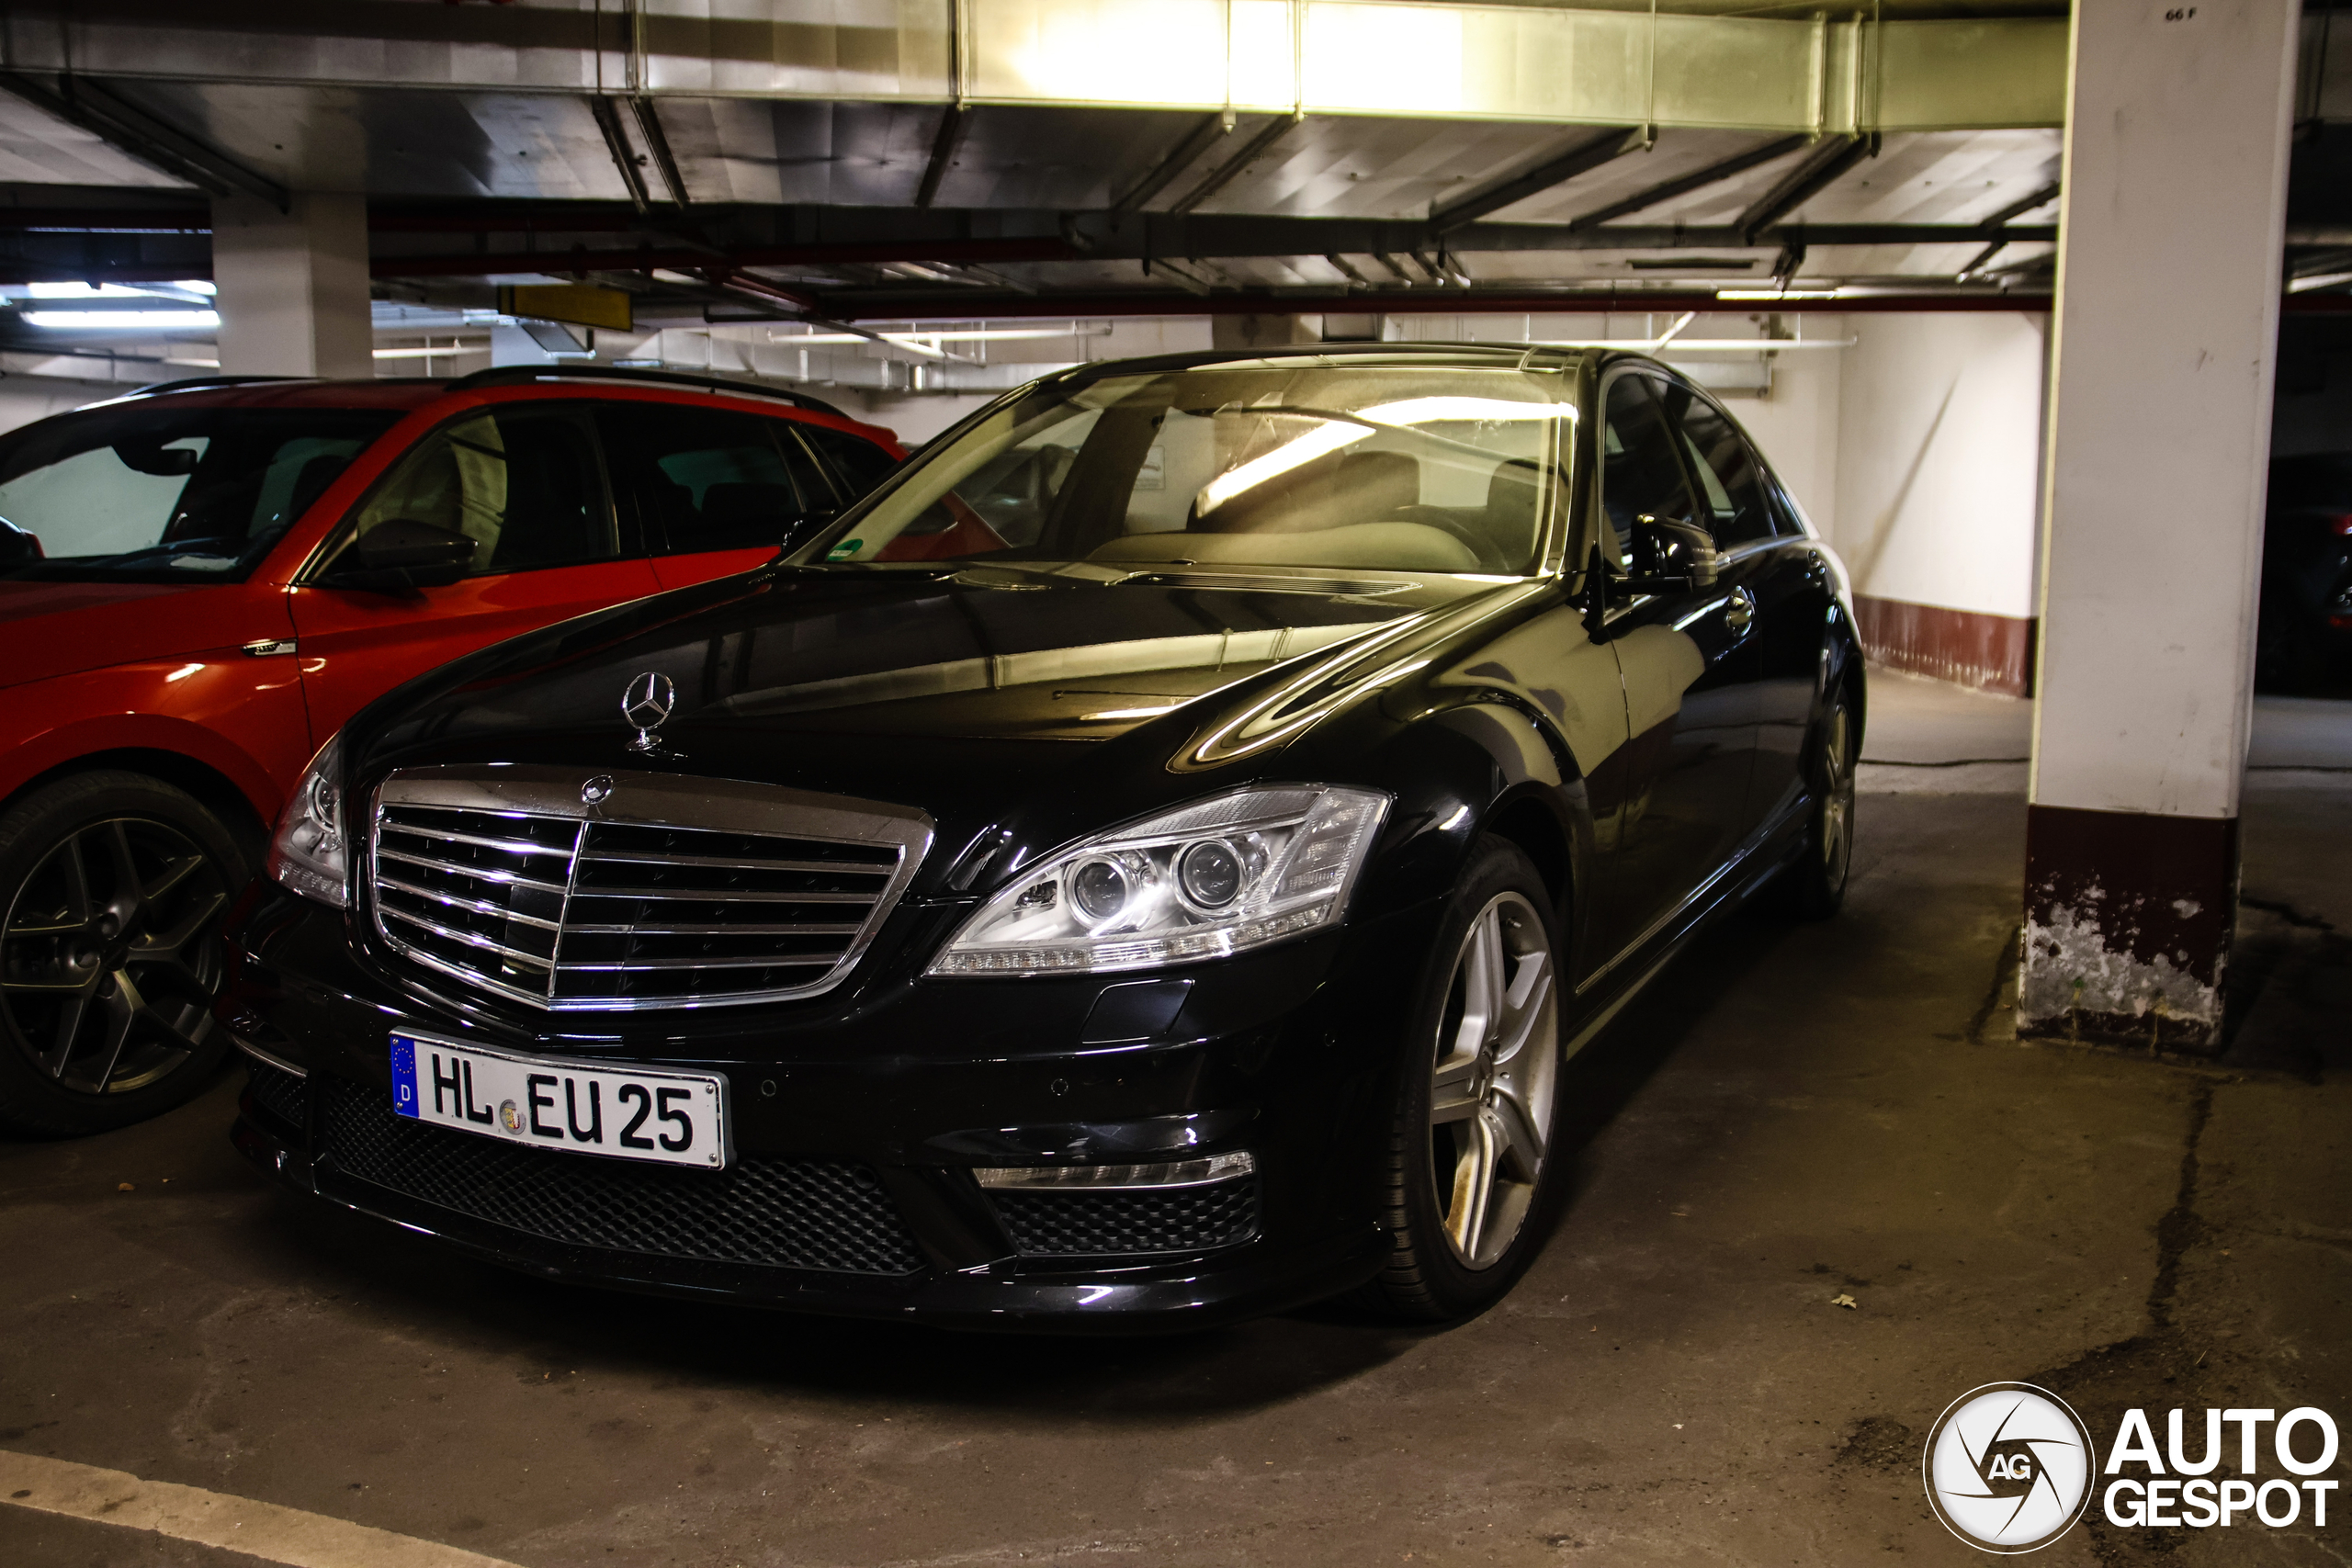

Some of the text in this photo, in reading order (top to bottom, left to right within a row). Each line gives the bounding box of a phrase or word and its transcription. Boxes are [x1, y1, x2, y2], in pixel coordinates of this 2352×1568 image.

[401, 1084, 411, 1101] D
[433, 1052, 694, 1152] HL EU 25
